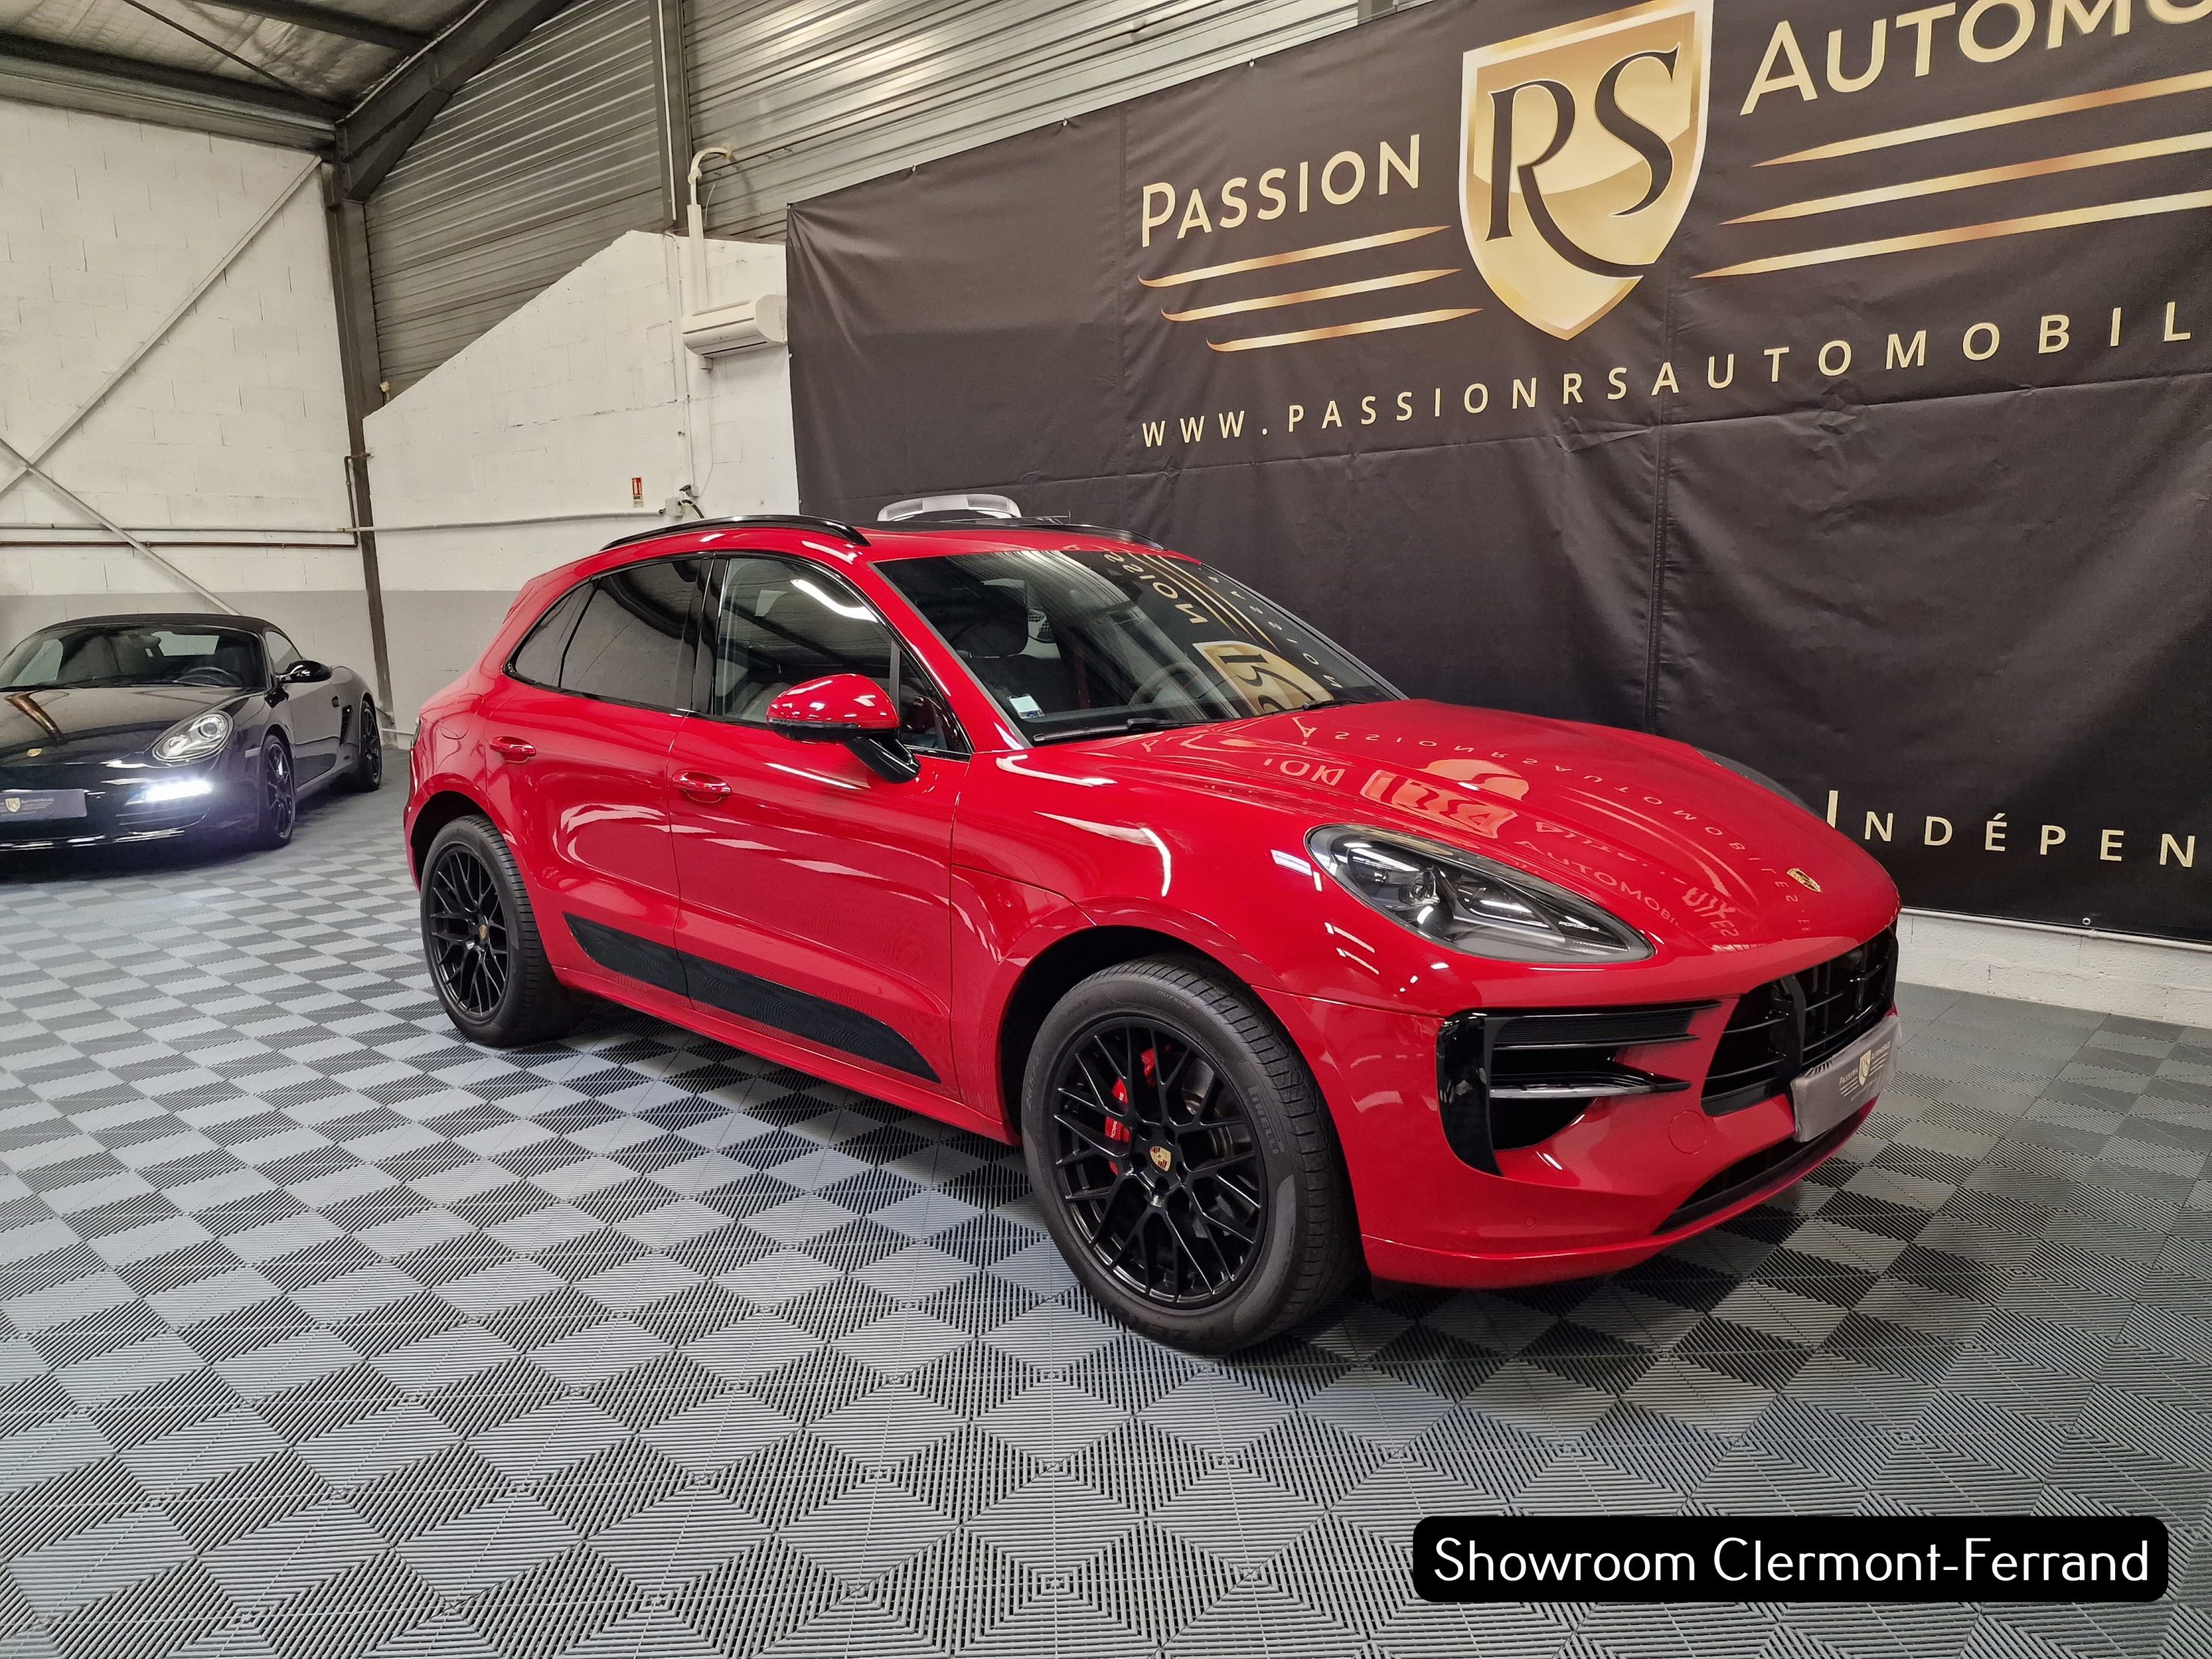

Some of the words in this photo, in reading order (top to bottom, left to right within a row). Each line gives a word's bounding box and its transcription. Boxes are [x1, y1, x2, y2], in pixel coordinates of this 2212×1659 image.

[1141, 133, 1420, 248] PASSION
[1485, 41, 1682, 280] RS
[1141, 300, 2192, 448] WWW.PASSIONRSAUTOMOBIL
